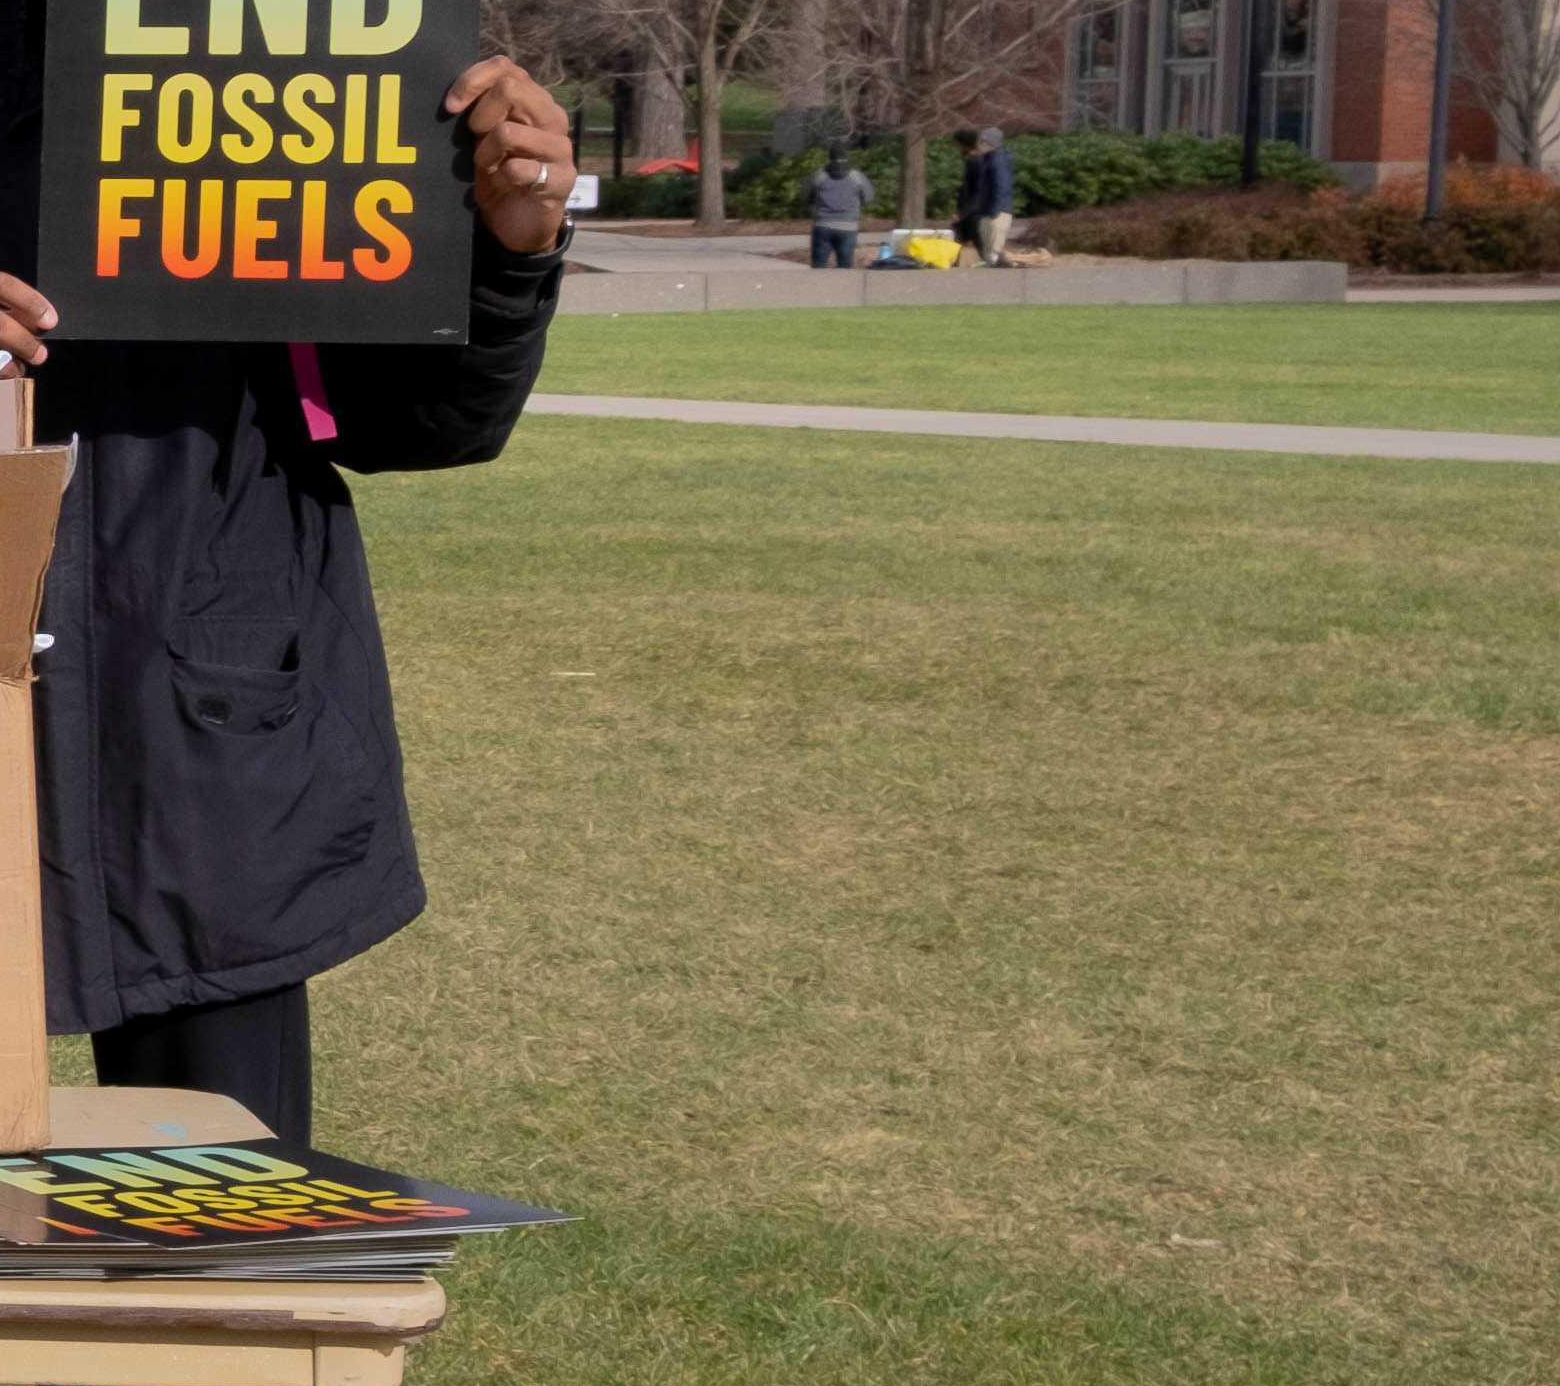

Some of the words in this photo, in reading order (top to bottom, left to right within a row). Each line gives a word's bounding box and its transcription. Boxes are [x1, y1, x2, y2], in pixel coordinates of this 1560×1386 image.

[99, 72, 417, 165] FOSSIL
[96, 177, 414, 283] FUELS
[53, 1178, 402, 1223] FOSSIL
[119, 1197, 472, 1236] FUELS
